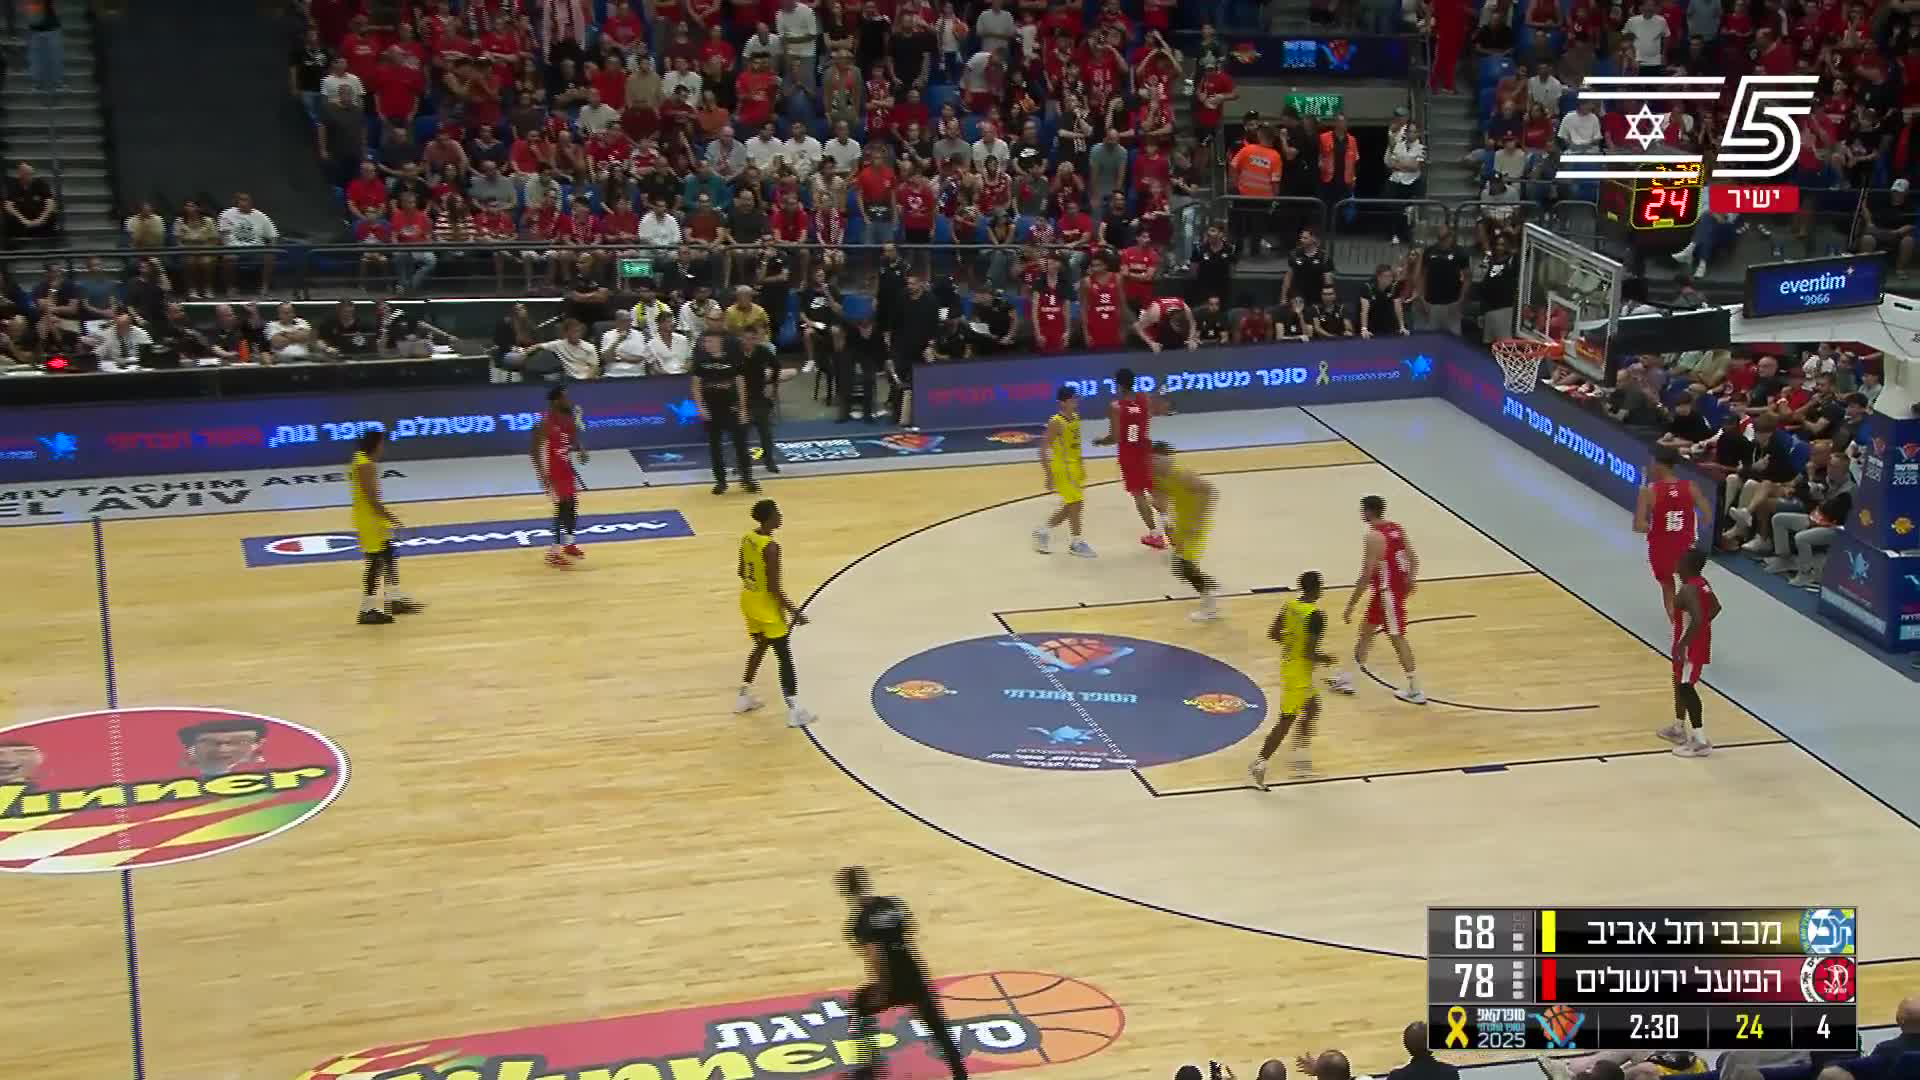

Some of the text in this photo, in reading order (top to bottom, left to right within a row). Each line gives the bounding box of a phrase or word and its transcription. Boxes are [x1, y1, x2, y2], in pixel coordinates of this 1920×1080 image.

[1645, 188, 1689, 221] 24
[1780, 272, 1846, 295] eventim
[1103, 375, 1155, 395] סור
[1160, 370, 1251, 395] משתלם,
[1256, 367, 1308, 386] סופר
[390, 415, 497, 442] משתלם,
[1525, 406, 1553, 437] סופר
[268, 424, 318, 448] נוח,
[260, 468, 408, 488] AREA
[1606, 451, 1637, 484] סופר
[88, 488, 253, 514] AVIV
[1664, 510, 1685, 533] 15
